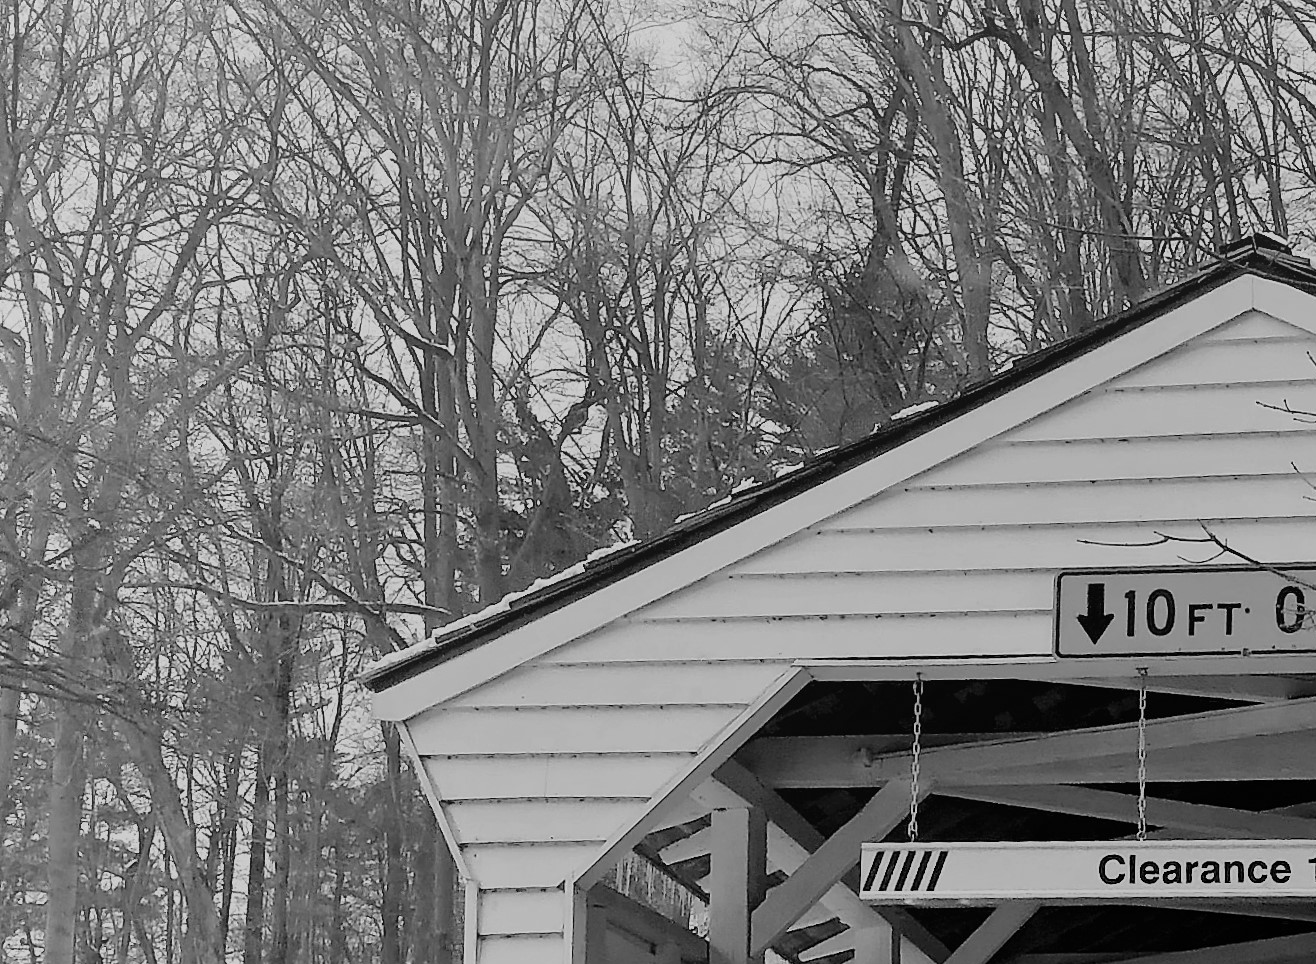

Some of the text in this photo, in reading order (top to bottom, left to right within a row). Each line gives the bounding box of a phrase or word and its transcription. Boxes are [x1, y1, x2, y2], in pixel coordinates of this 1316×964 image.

[1124, 588, 1176, 637] 10
[1275, 585, 1306, 634] 0
[1098, 853, 1292, 885] Clearance
